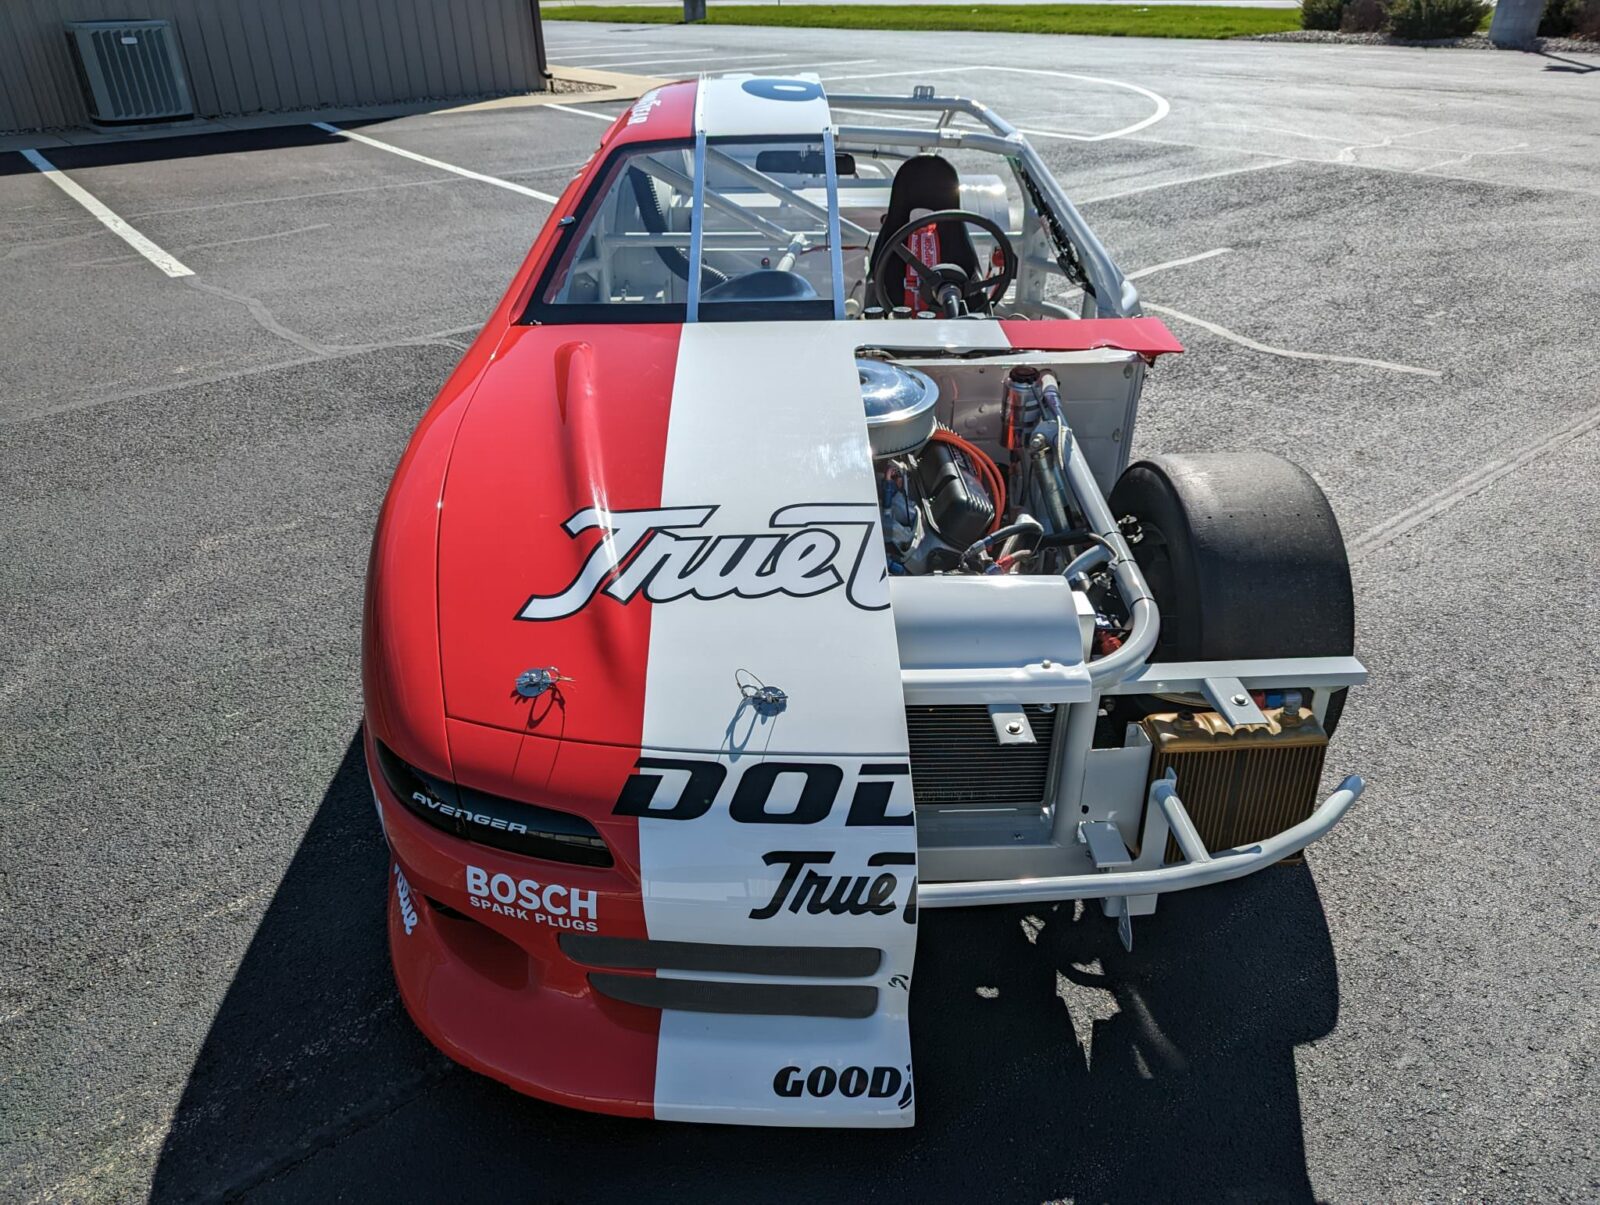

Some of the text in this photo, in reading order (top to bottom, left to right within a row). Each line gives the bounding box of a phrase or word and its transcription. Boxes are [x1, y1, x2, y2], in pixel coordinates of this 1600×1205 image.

[413, 792, 527, 834] AVENGER
[466, 865, 597, 919] BOSCH
[470, 896, 598, 933] SPARK PLUGS
[773, 1065, 903, 1098] GOOD
